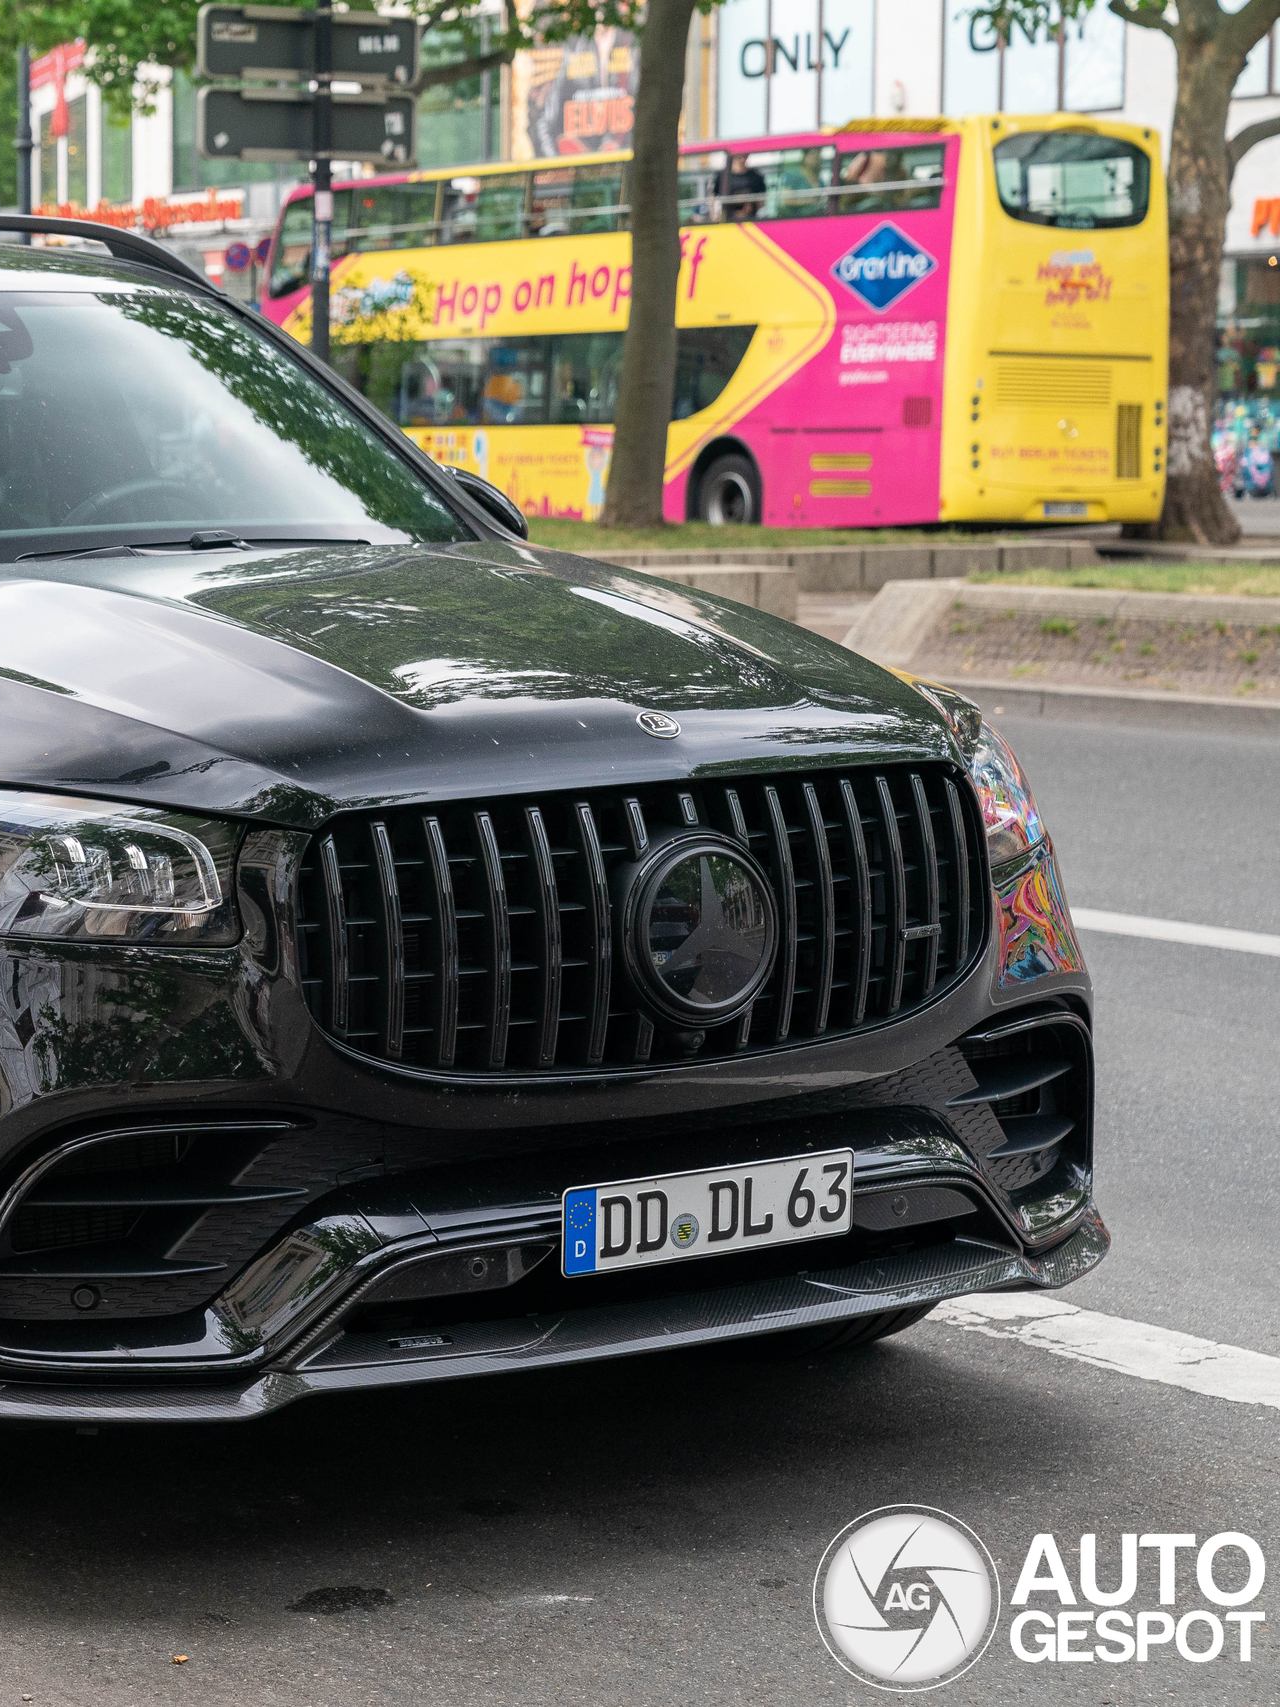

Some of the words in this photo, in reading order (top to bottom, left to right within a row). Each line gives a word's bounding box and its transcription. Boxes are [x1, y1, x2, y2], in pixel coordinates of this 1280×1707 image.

[740, 27, 850, 78] ONLY
[563, 95, 635, 138] ELVIS
[434, 280, 501, 330] Hop
[514, 273, 554, 313] on
[567, 261, 632, 314] hop
[839, 341, 937, 364] EVERYWHERE
[841, 321, 938, 342] SIGHTSEEING
[600, 1188, 668, 1258] DD
[708, 1176, 773, 1242] DL
[787, 1161, 848, 1227] 63
[575, 1240, 586, 1258] D
